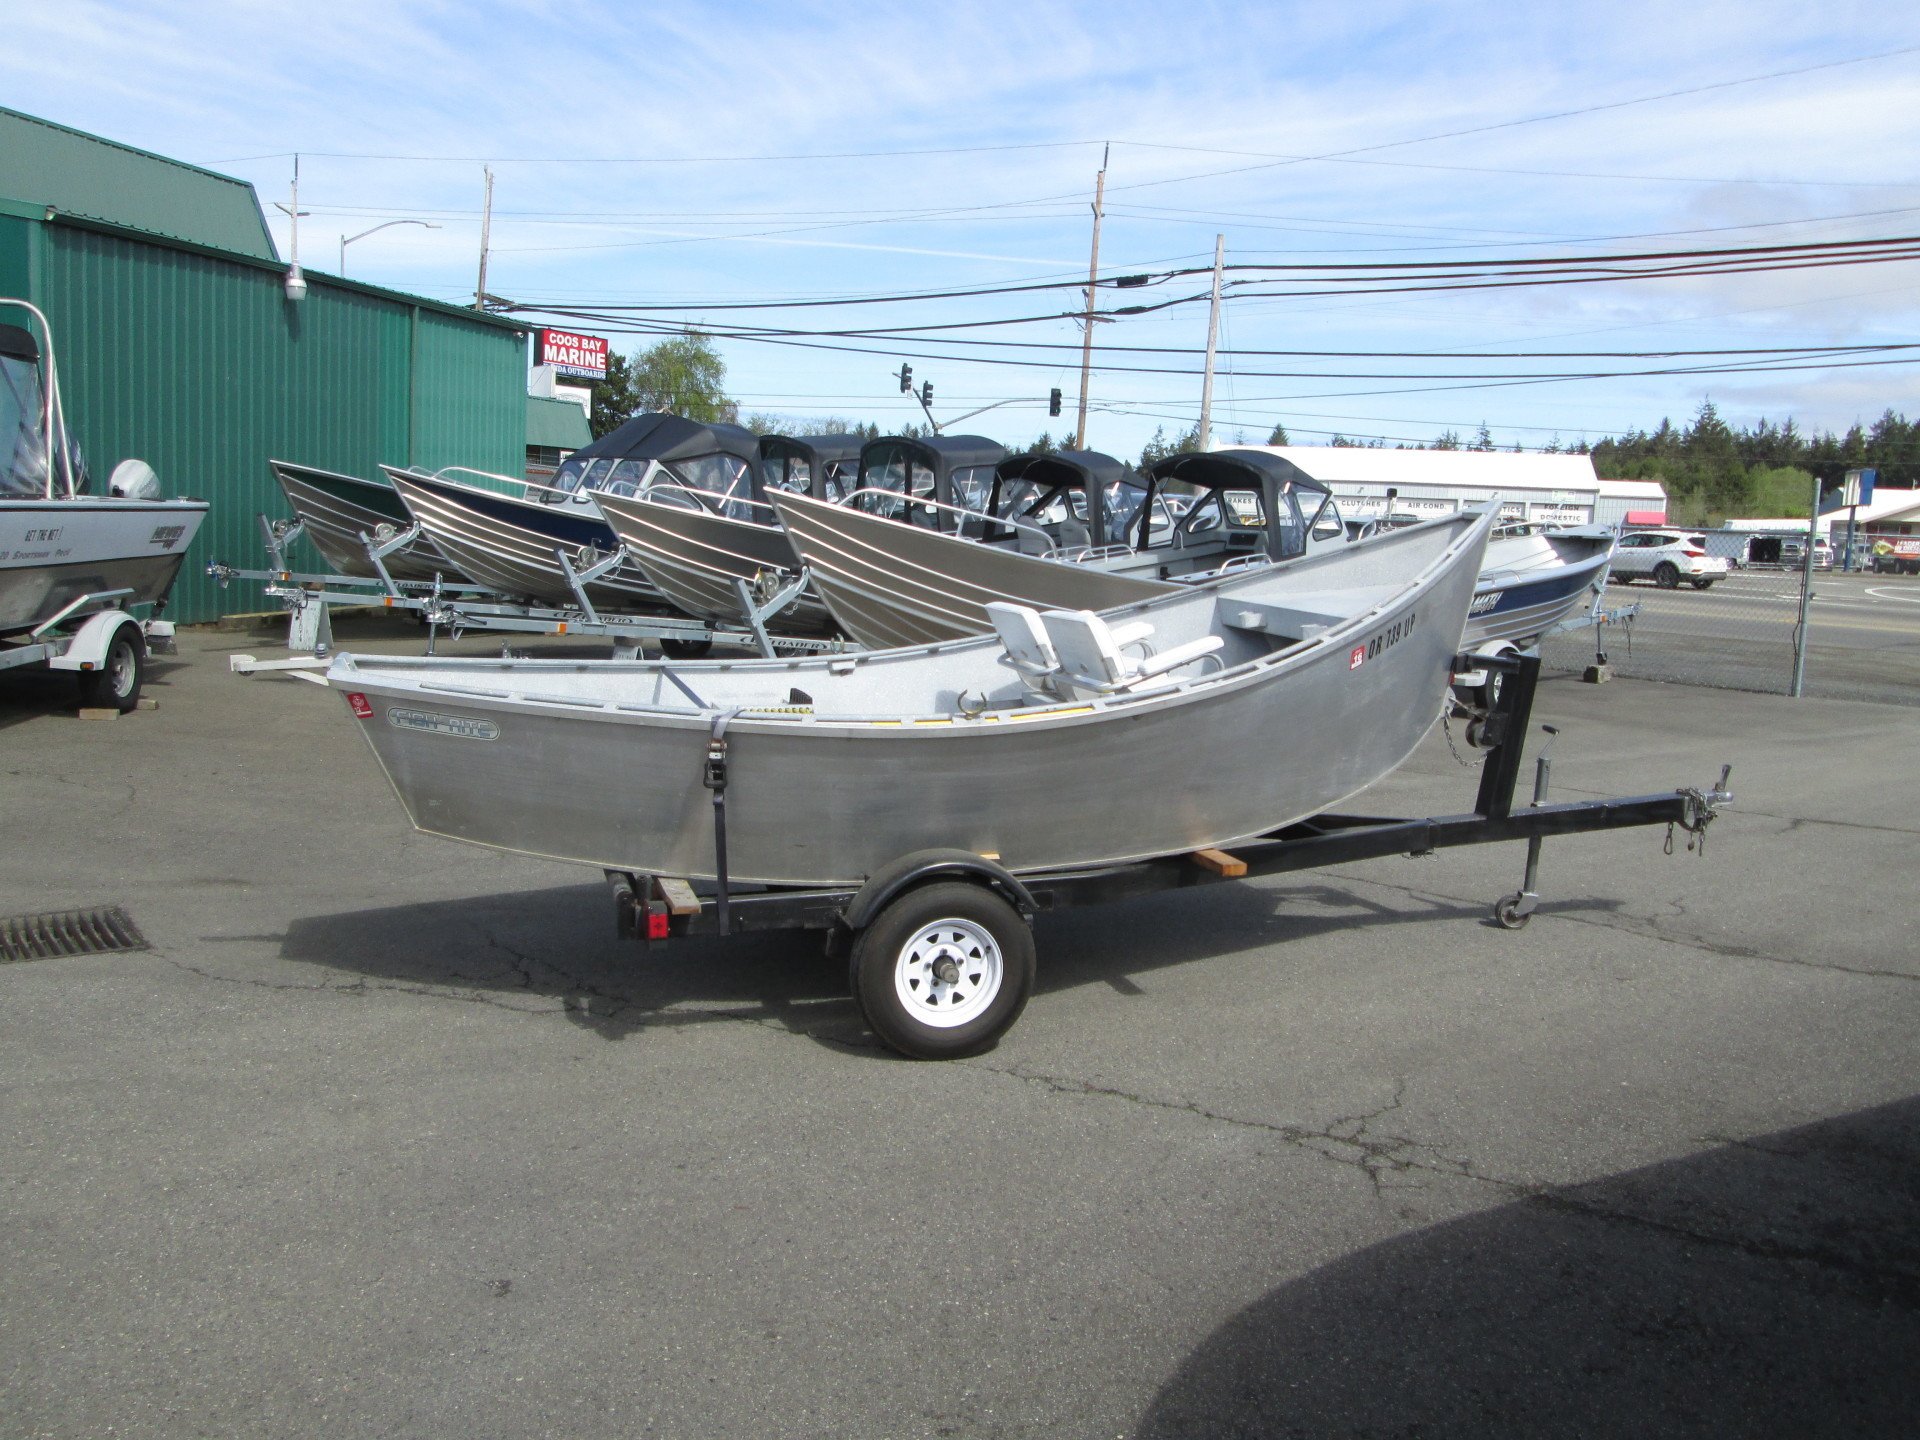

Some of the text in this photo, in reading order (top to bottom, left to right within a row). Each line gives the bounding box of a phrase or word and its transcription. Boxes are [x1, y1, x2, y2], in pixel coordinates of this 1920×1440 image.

[549, 333, 602, 351] COOS BAY
[544, 344, 606, 369] MARINE
[567, 367, 606, 379] OUTBOARDS
[1368, 635, 1383, 660] OR
[1404, 613, 1416, 638] UP
